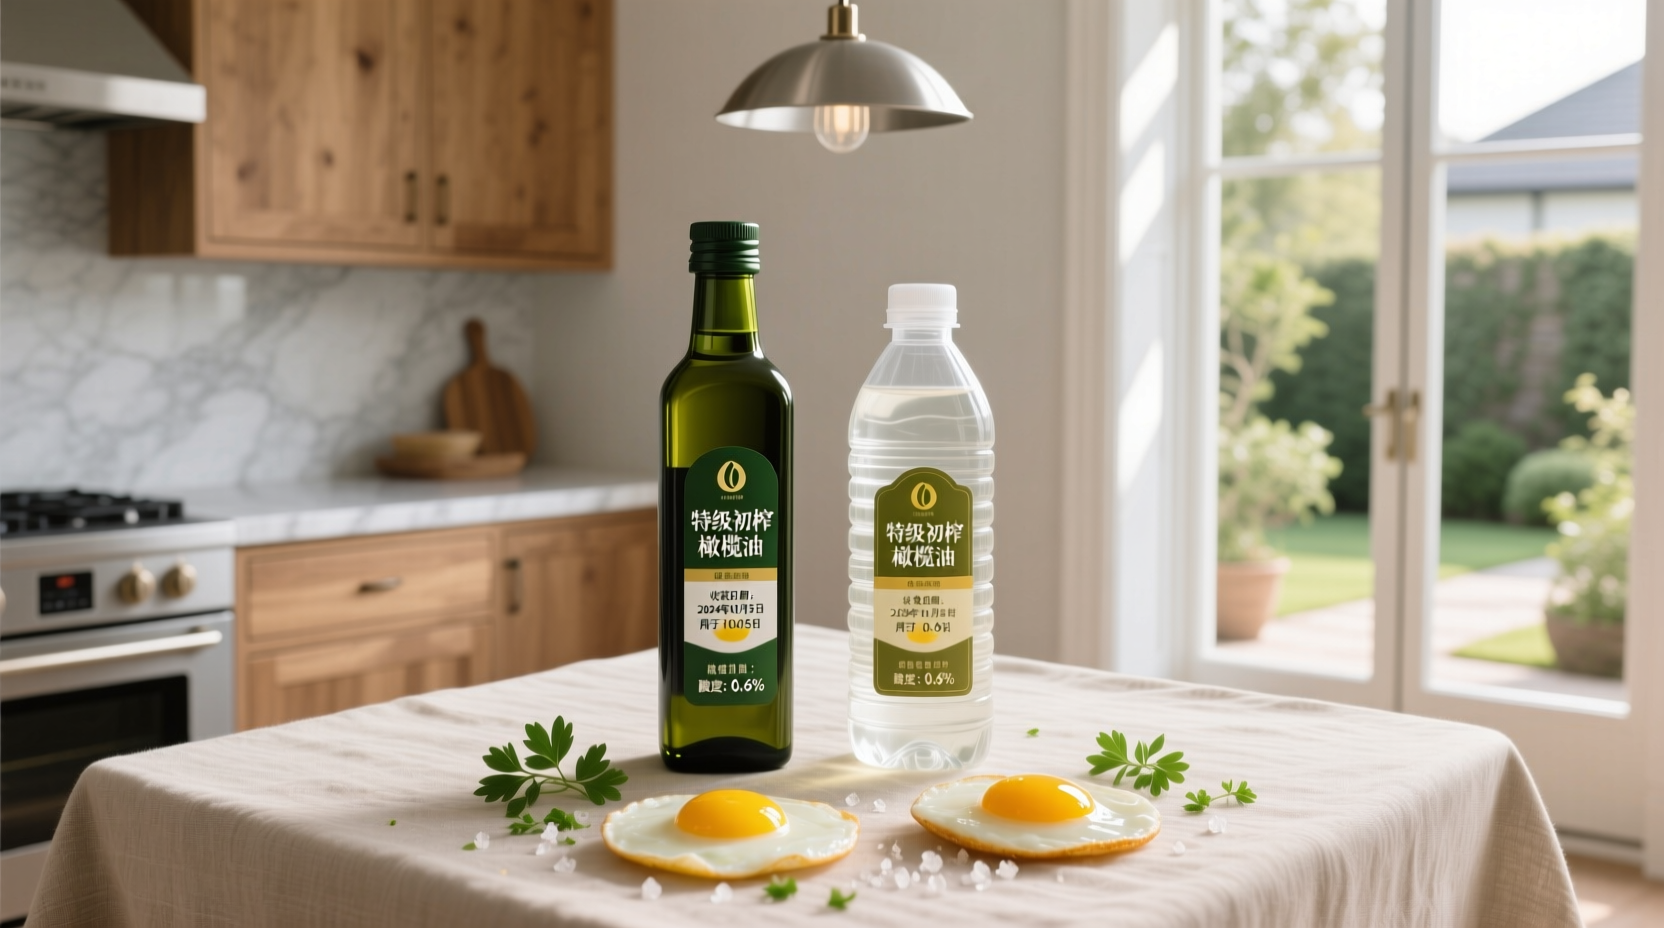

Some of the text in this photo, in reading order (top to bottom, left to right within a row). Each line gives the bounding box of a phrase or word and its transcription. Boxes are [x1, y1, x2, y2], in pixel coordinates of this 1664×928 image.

[691, 508, 774, 532] 特级初榨
[886, 520, 964, 544] 特级初榨
[698, 534, 763, 558] 橄榄油
[731, 678, 765, 693] 0.6%
